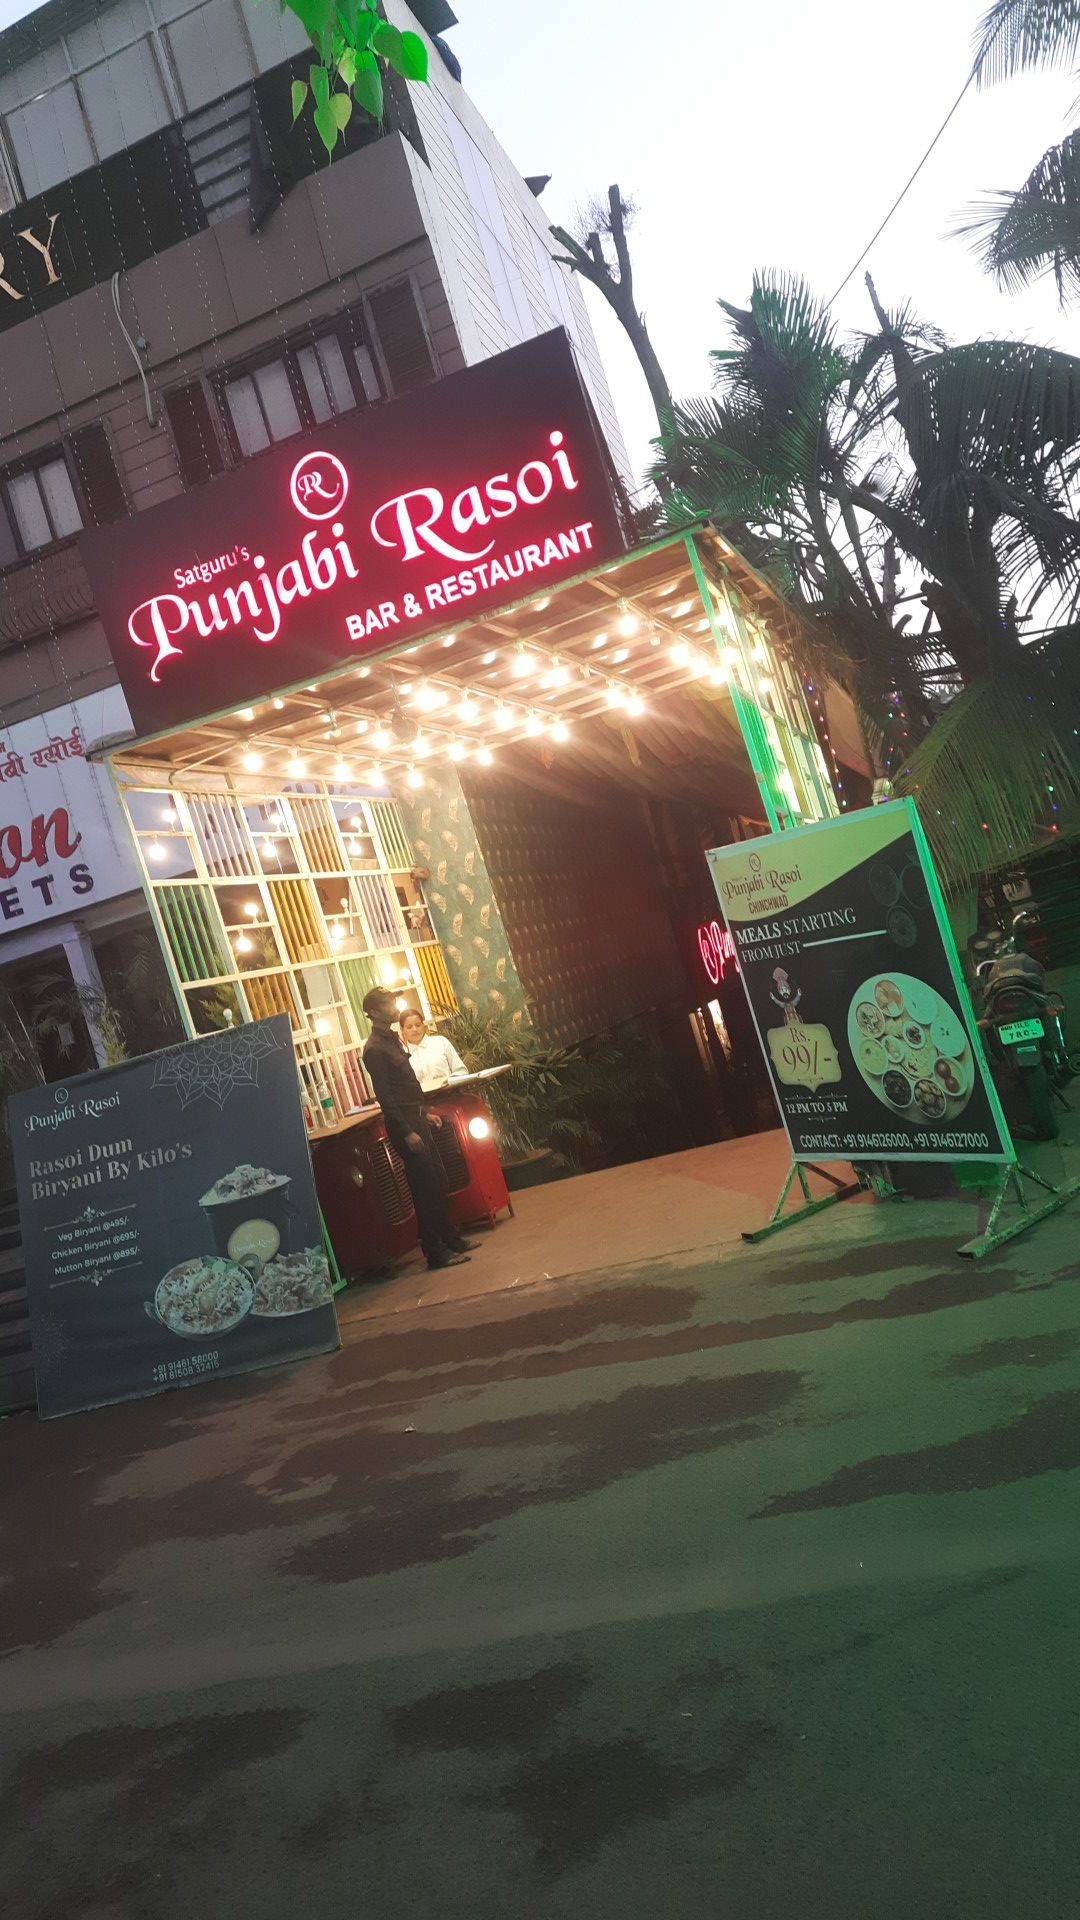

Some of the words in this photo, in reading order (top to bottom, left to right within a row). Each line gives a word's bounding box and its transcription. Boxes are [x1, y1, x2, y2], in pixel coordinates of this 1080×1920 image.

[127, 522, 359, 682] Punjabi
[370, 430, 579, 562] Rasoi
[174, 545, 250, 589] Satguru's
[345, 600, 400, 641] BAR
[404, 594, 422, 618] &
[425, 522, 594, 611] RESTAURANT
[0, 864, 94, 920] ETS
[721, 874, 765, 904] Punjabi
[765, 864, 802, 893] Rasoi
[748, 894, 789, 914] CHINCHWAD
[735, 922, 782, 945] MEALS
[783, 907, 857, 936] STARTING
[741, 946, 774, 963] FROM
[774, 941, 800, 959] JUST
[789, 1027, 810, 1044] Rs.
[782, 1040, 832, 1075] 99/-
[24, 1105, 76, 1136] Punjabi
[79, 1091, 121, 1118] Rasoi
[798, 1103, 810, 1114] PM
[811, 1103, 825, 1113] TO
[833, 1101, 848, 1112] PM
[30, 1149, 82, 1178] Rasoi
[88, 1138, 132, 1162] Dum
[800, 1134, 842, 1148] CONTACT:
[843, 1136, 858, 1147] +91
[914, 1135, 929, 1147] +91
[31, 1166, 102, 1200] Biryani
[108, 1161, 131, 1180] By
[137, 1142, 193, 1171] Kilo's
[51, 1246, 83, 1260] Chicken
[84, 1237, 111, 1251] Biryani
[57, 1233, 73, 1242] Veg
[75, 1225, 101, 1237] Biryani
[54, 1262, 83, 1275] Mutton
[84, 1254, 111, 1267] Biryani
